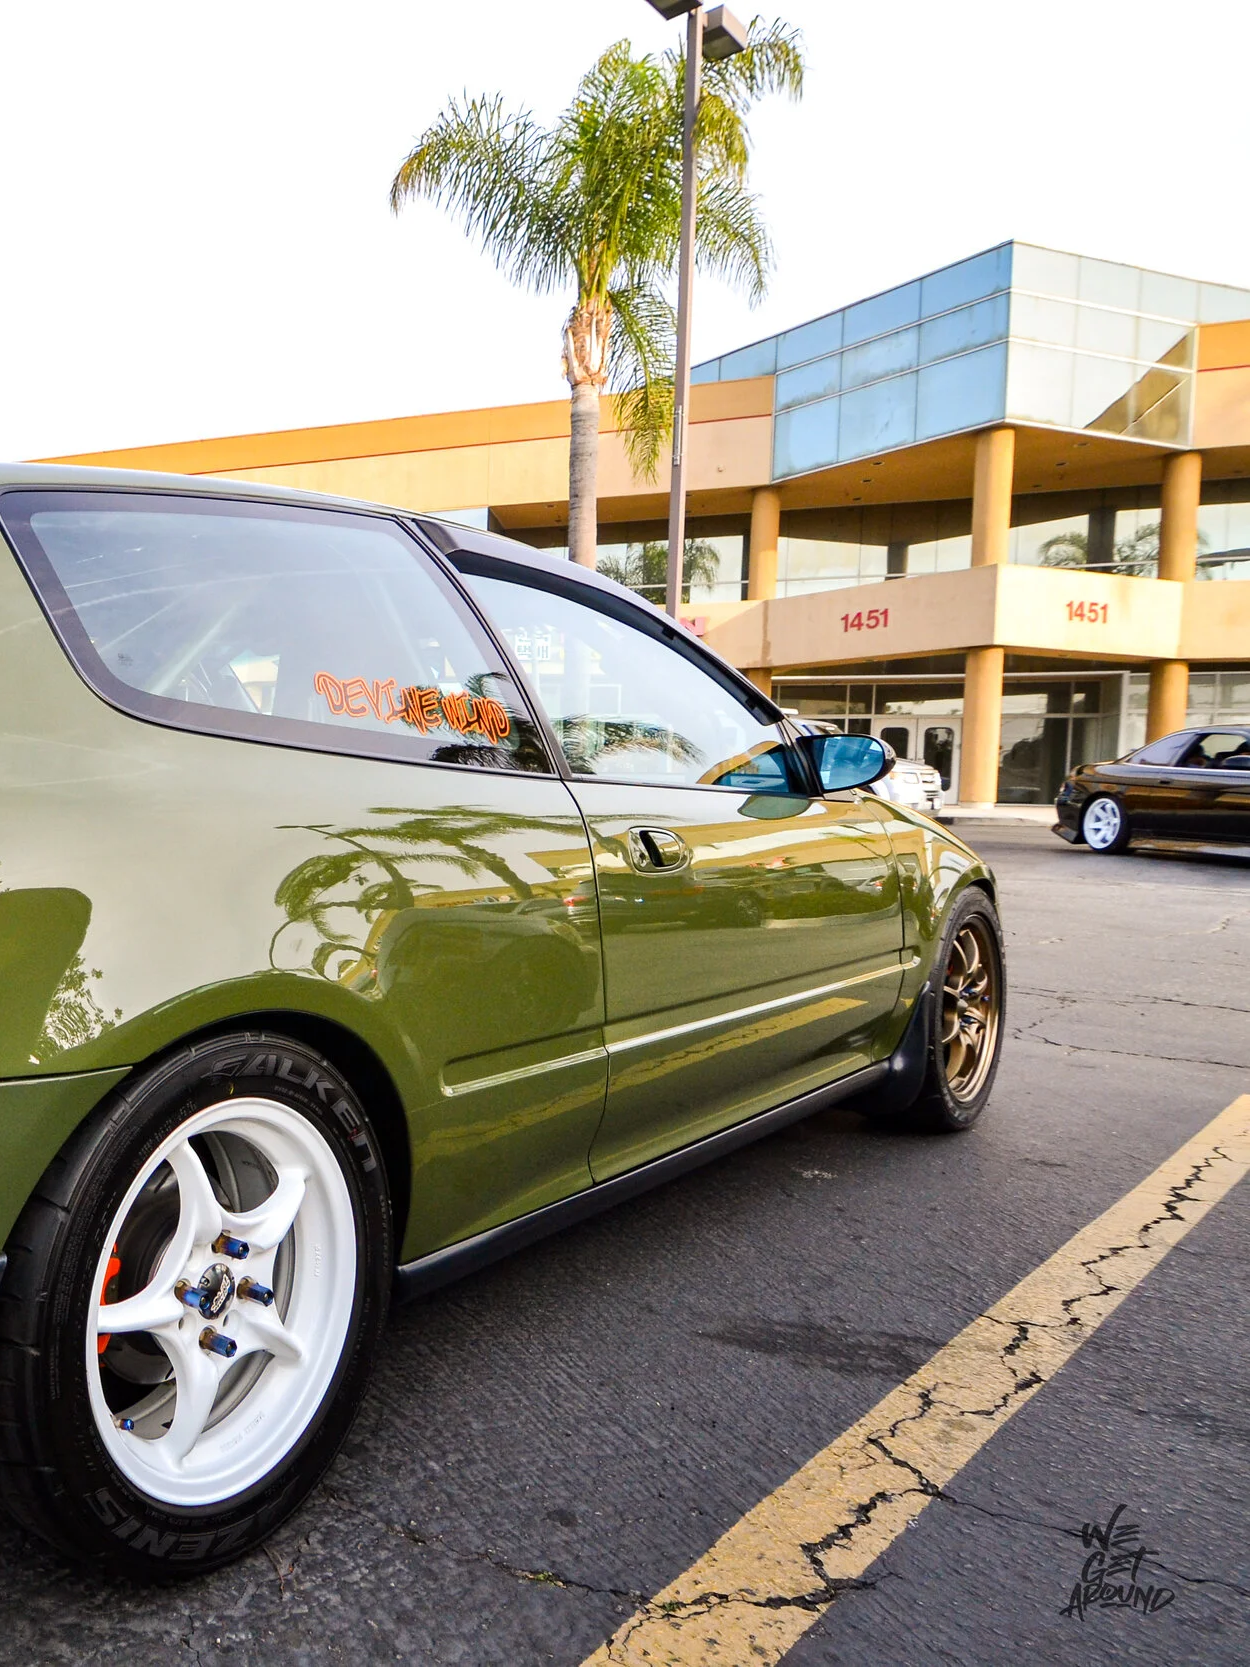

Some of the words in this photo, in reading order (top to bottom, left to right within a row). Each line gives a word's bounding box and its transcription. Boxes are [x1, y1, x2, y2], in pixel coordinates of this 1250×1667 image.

[840, 608, 890, 633] 1451
[1065, 600, 1109, 624] 1451
[314, 670, 442, 736] DEVINE
[441, 689, 510, 745] WIND
[203, 1053, 377, 1173] FALKEN
